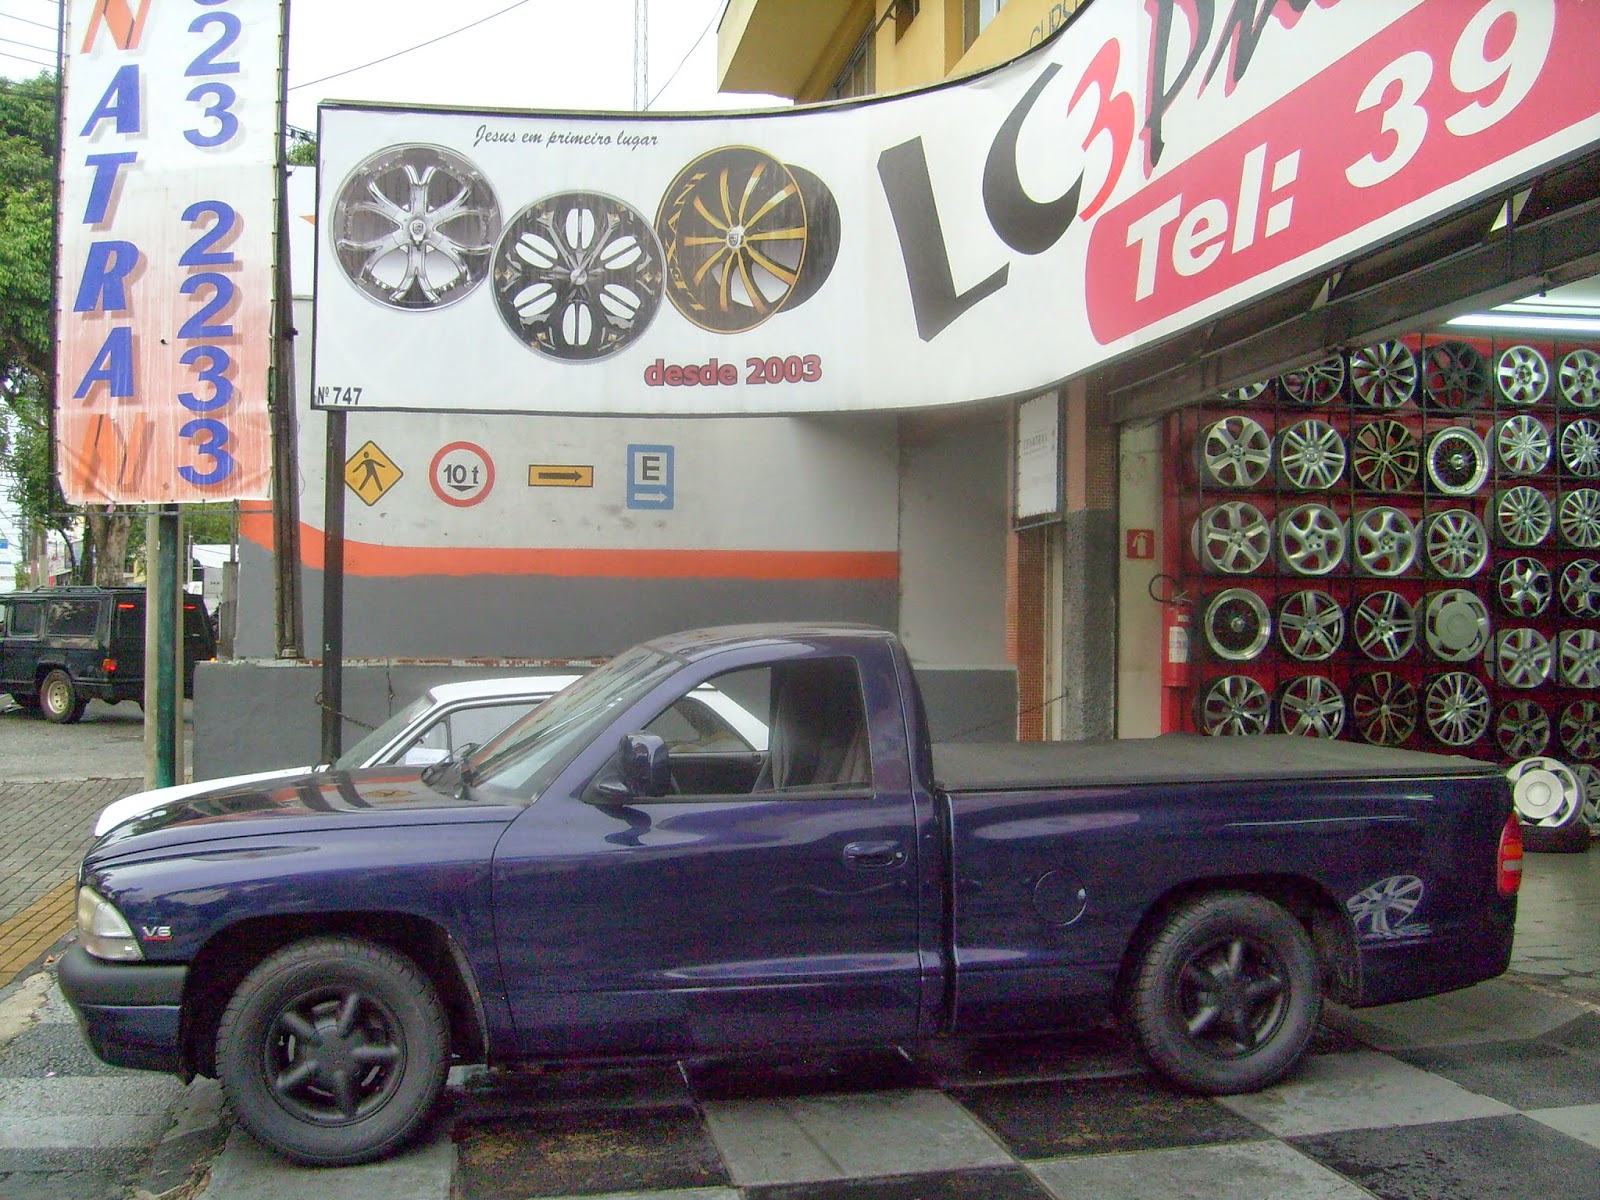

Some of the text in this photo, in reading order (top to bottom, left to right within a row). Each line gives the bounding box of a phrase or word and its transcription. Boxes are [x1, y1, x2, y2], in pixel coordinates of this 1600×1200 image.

[473, 124, 659, 151] Jesus em primeiro lugar
[1126, 0, 1556, 303] Tel: 39
[177, 0, 242, 486] 23 2233
[644, 354, 822, 386] desde 2003
[333, 387, 362, 405] 747
[443, 464, 467, 484] 10
[642, 456, 660, 481] E
[142, 926, 171, 937] V6
